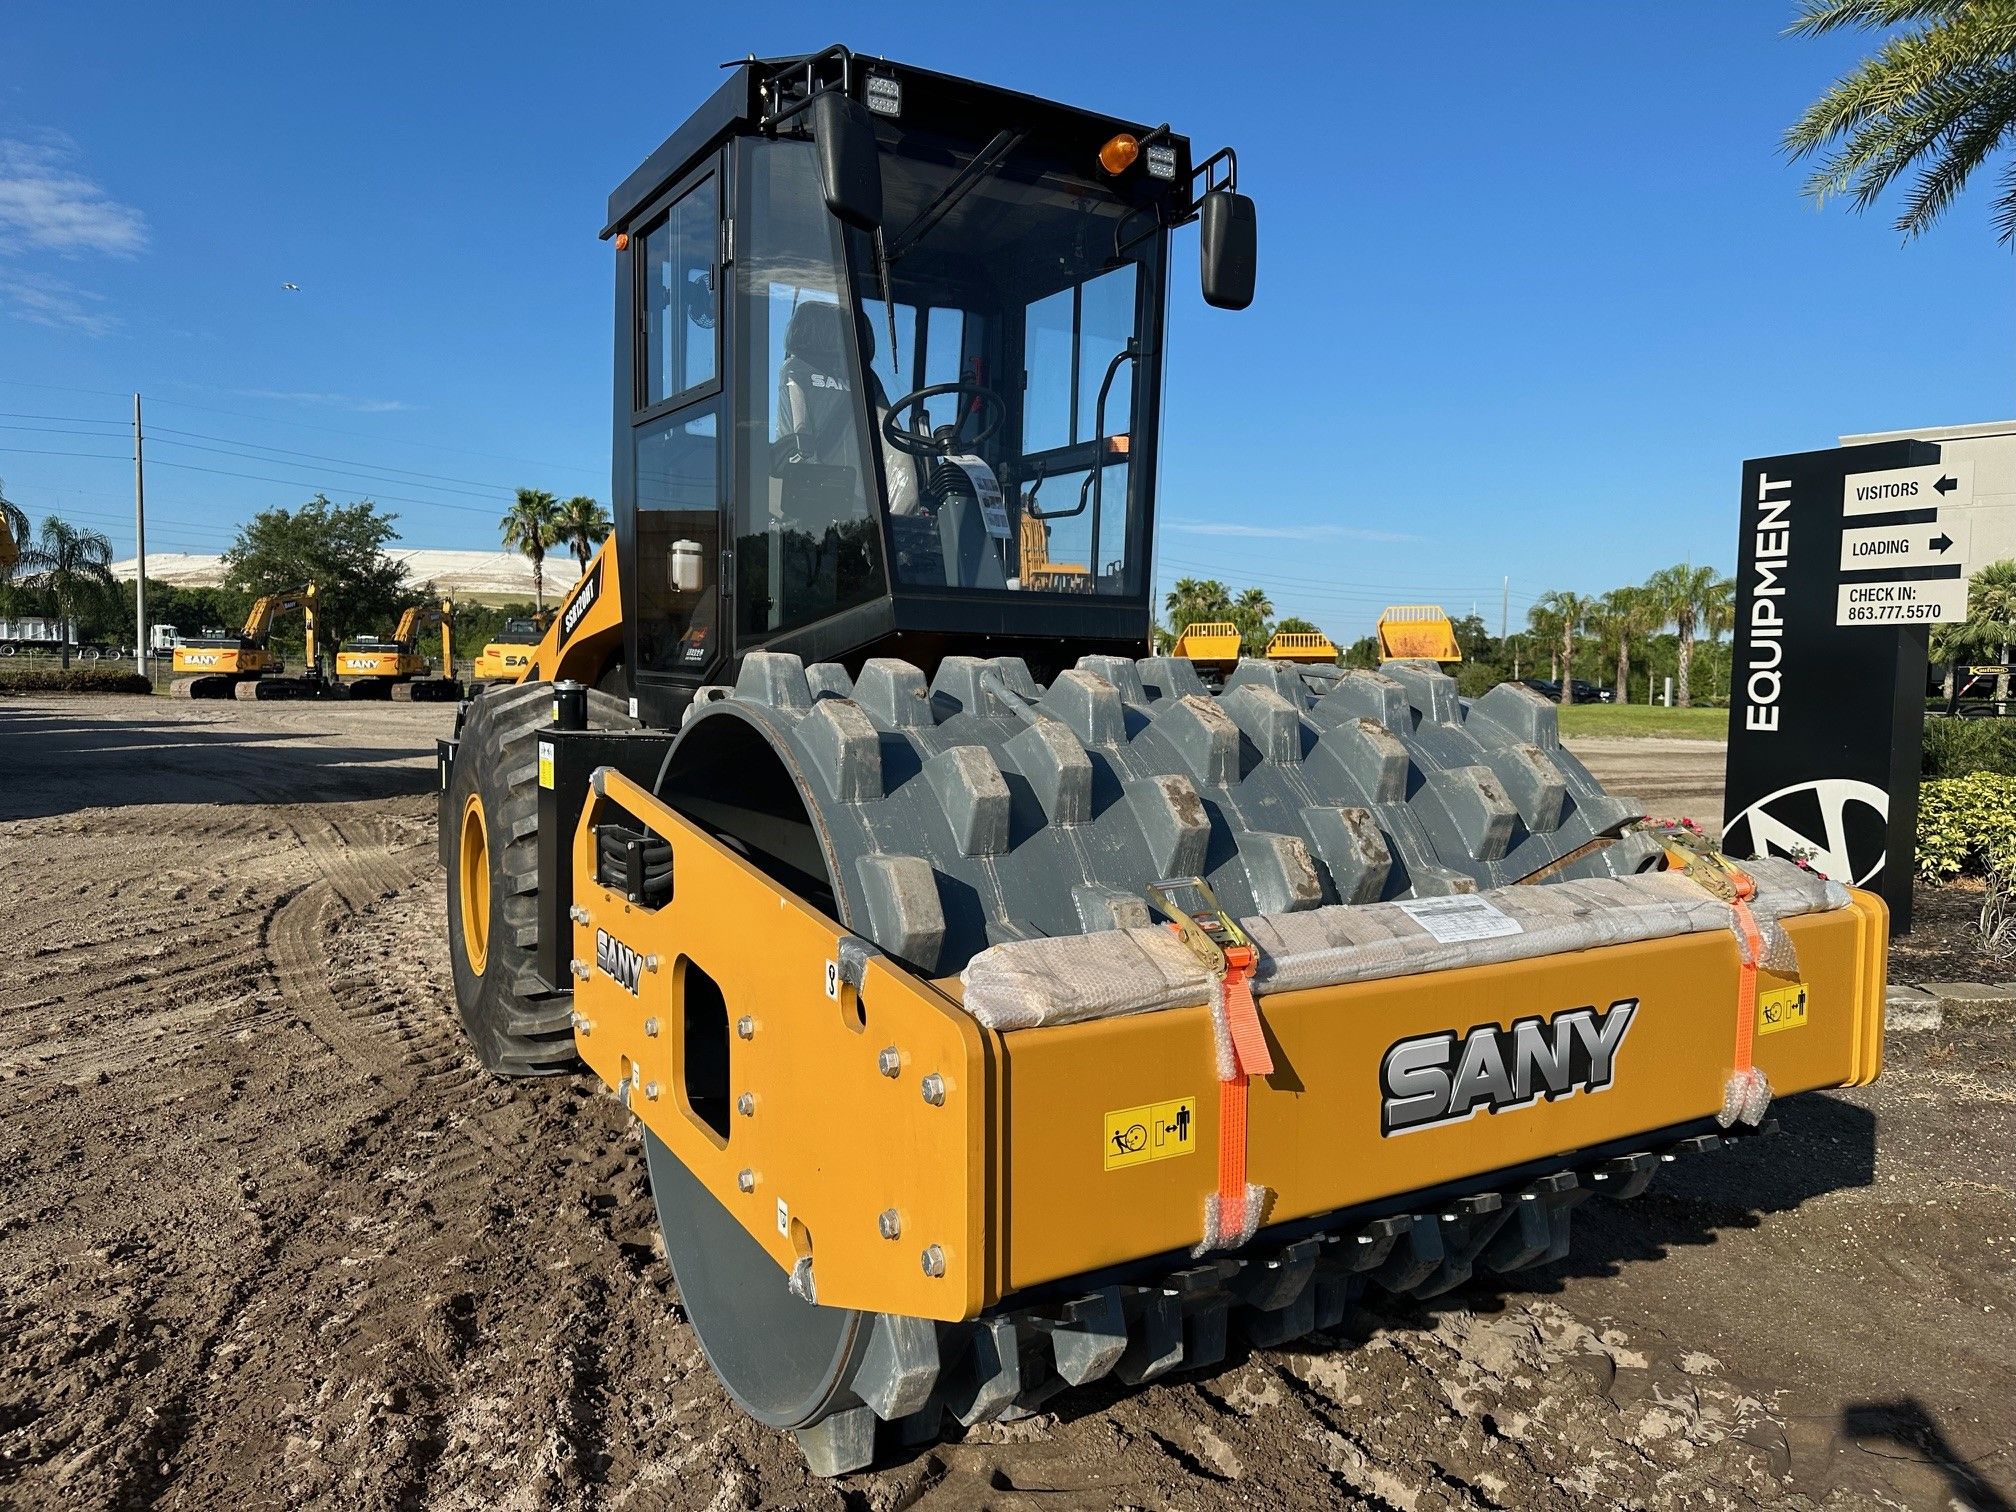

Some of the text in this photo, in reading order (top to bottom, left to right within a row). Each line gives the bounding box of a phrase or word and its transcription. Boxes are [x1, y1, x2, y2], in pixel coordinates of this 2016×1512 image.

[810, 373, 852, 391] SAN
[1856, 481, 1919, 501] VISITORS
[1852, 539, 1909, 556] LOADING
[1745, 472, 1792, 732] EQUIPMENT
[1849, 586, 1916, 602] CHECK IN:
[1848, 604, 1941, 620] 863.777.5570
[184, 655, 219, 665] SANY
[346, 659, 380, 668] SANY
[505, 655, 529, 666] SA
[597, 928, 643, 997] SANY
[1382, 1002, 1636, 1132] SANY
